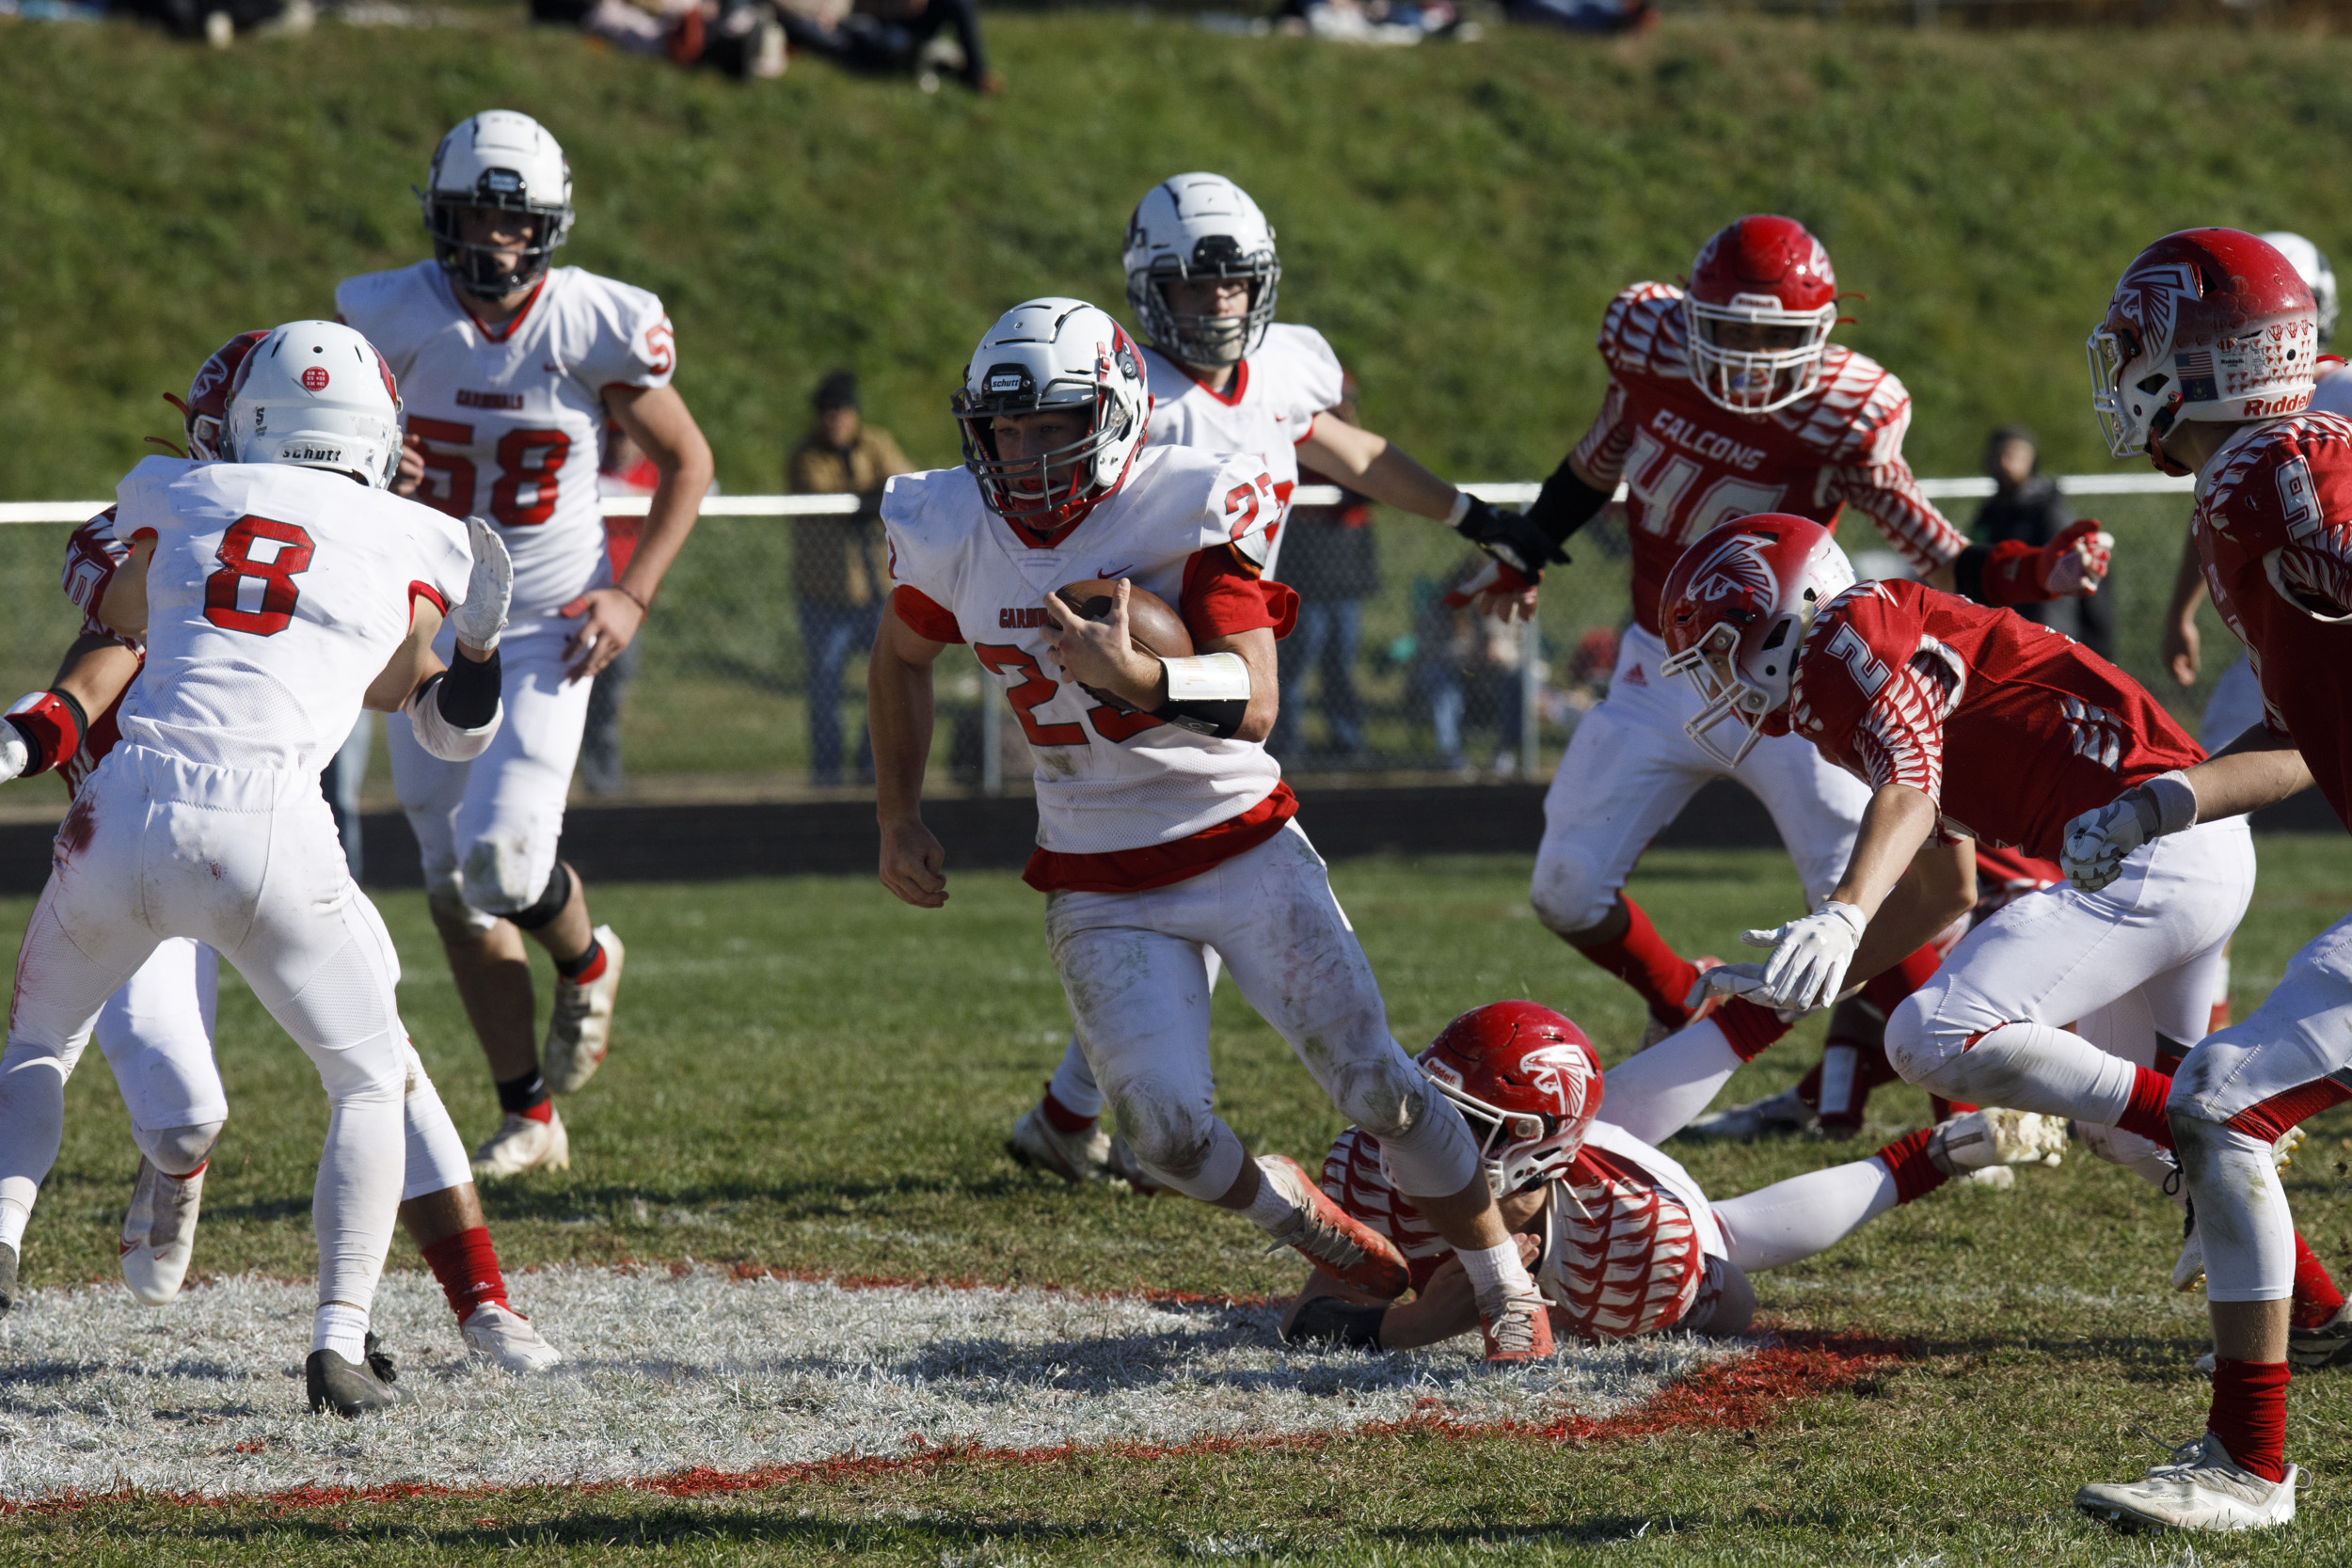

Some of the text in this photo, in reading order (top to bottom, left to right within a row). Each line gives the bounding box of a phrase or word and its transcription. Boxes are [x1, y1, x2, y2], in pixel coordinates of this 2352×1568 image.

[993, 378, 1019, 388] schutt
[2243, 388, 2315, 418] Riddell
[282, 445, 342, 462] schutt
[406, 415, 571, 527] 58
[1652, 408, 1767, 470] FALCONS
[2275, 454, 2324, 543] 9
[202, 514, 316, 637] 8
[1824, 621, 1893, 701] 2
